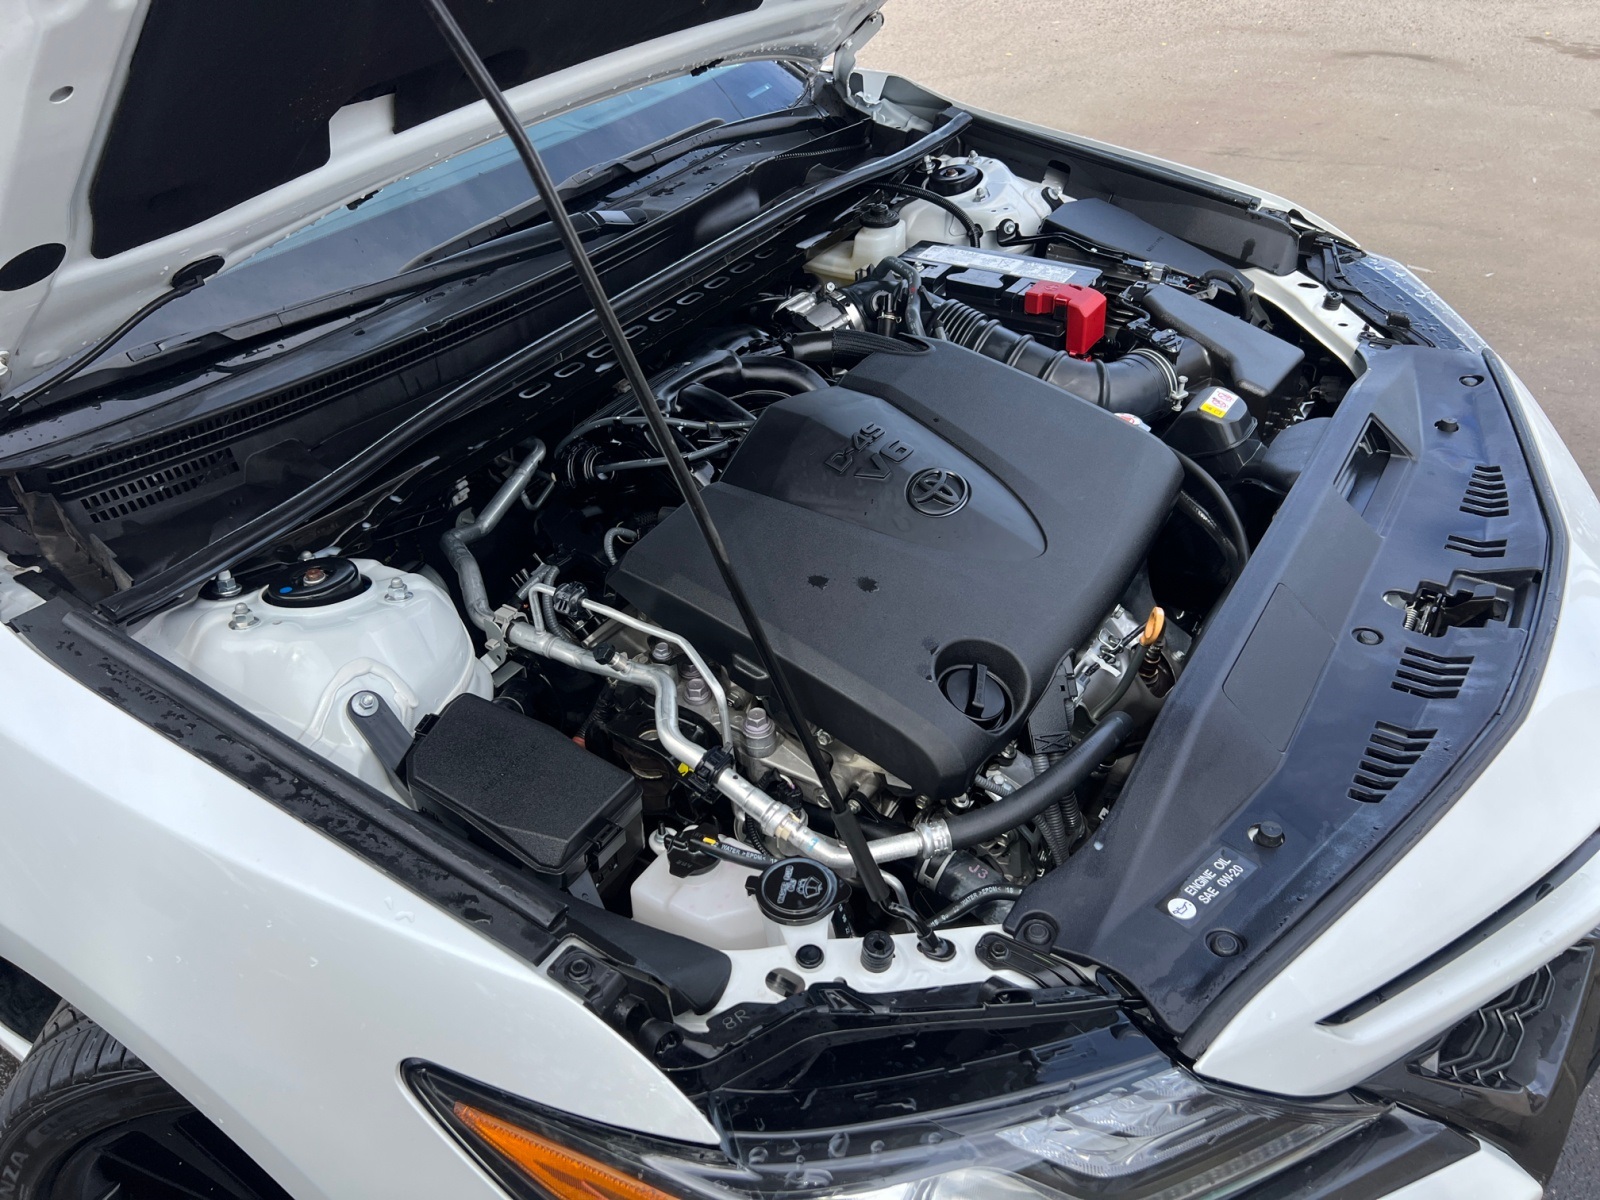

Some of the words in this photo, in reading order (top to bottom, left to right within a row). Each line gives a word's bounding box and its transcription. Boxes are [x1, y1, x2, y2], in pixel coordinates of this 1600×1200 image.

[825, 421, 886, 474] D-4S
[854, 440, 914, 481] V6
[722, 844, 740, 854] WATER
[968, 864, 988, 879] J3
[1184, 869, 1217, 896] ENGINE
[1213, 857, 1232, 870] OIL
[1198, 886, 1220, 904] SAE
[1216, 864, 1244, 887] 0W-20
[961, 893, 979, 906] WATER
[722, 1009, 751, 1030] 8R
